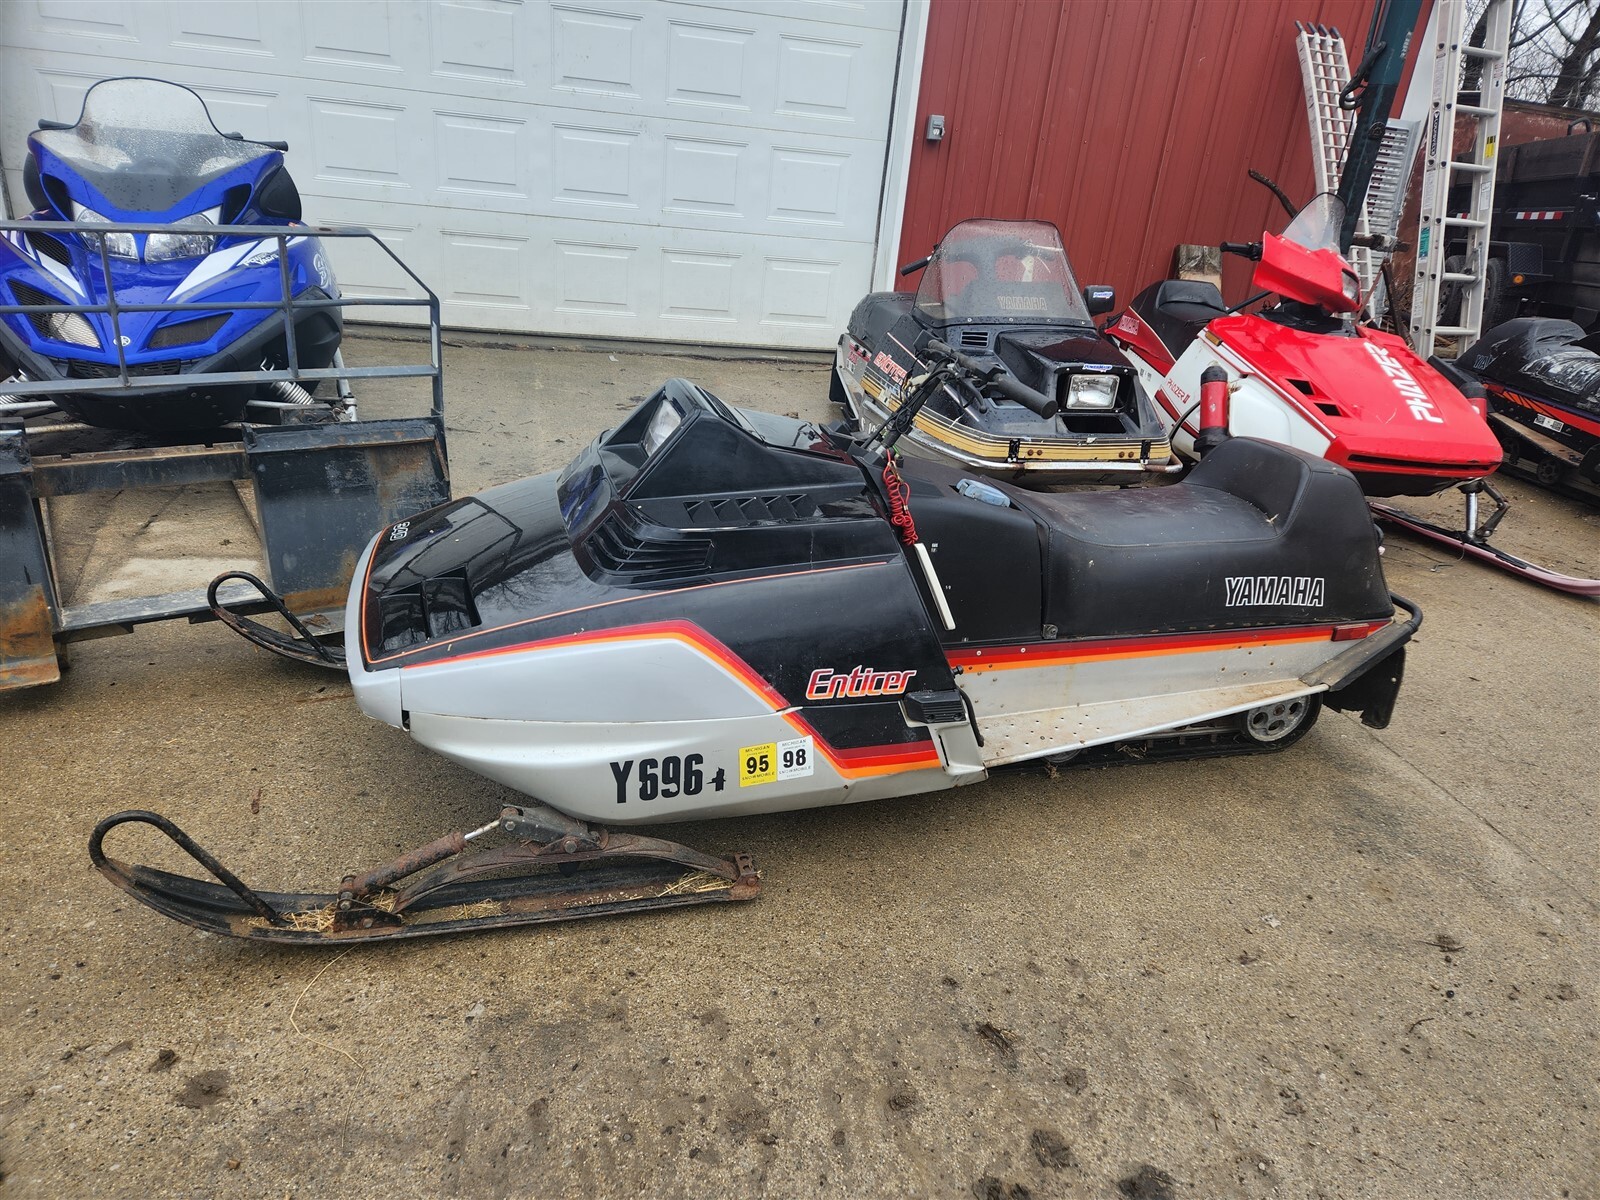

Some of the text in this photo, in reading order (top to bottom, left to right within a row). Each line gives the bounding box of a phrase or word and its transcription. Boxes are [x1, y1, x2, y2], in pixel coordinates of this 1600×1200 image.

[997, 296, 1048, 311] YAMAHA
[1363, 341, 1444, 424] PHAZER
[1224, 576, 1325, 607] YAMAHA
[805, 664, 917, 700] Enticer
[745, 745, 770, 753] MICHIGAN
[781, 739, 807, 747] MICHIGAN
[746, 754, 769, 775] 95
[783, 748, 807, 769] 98
